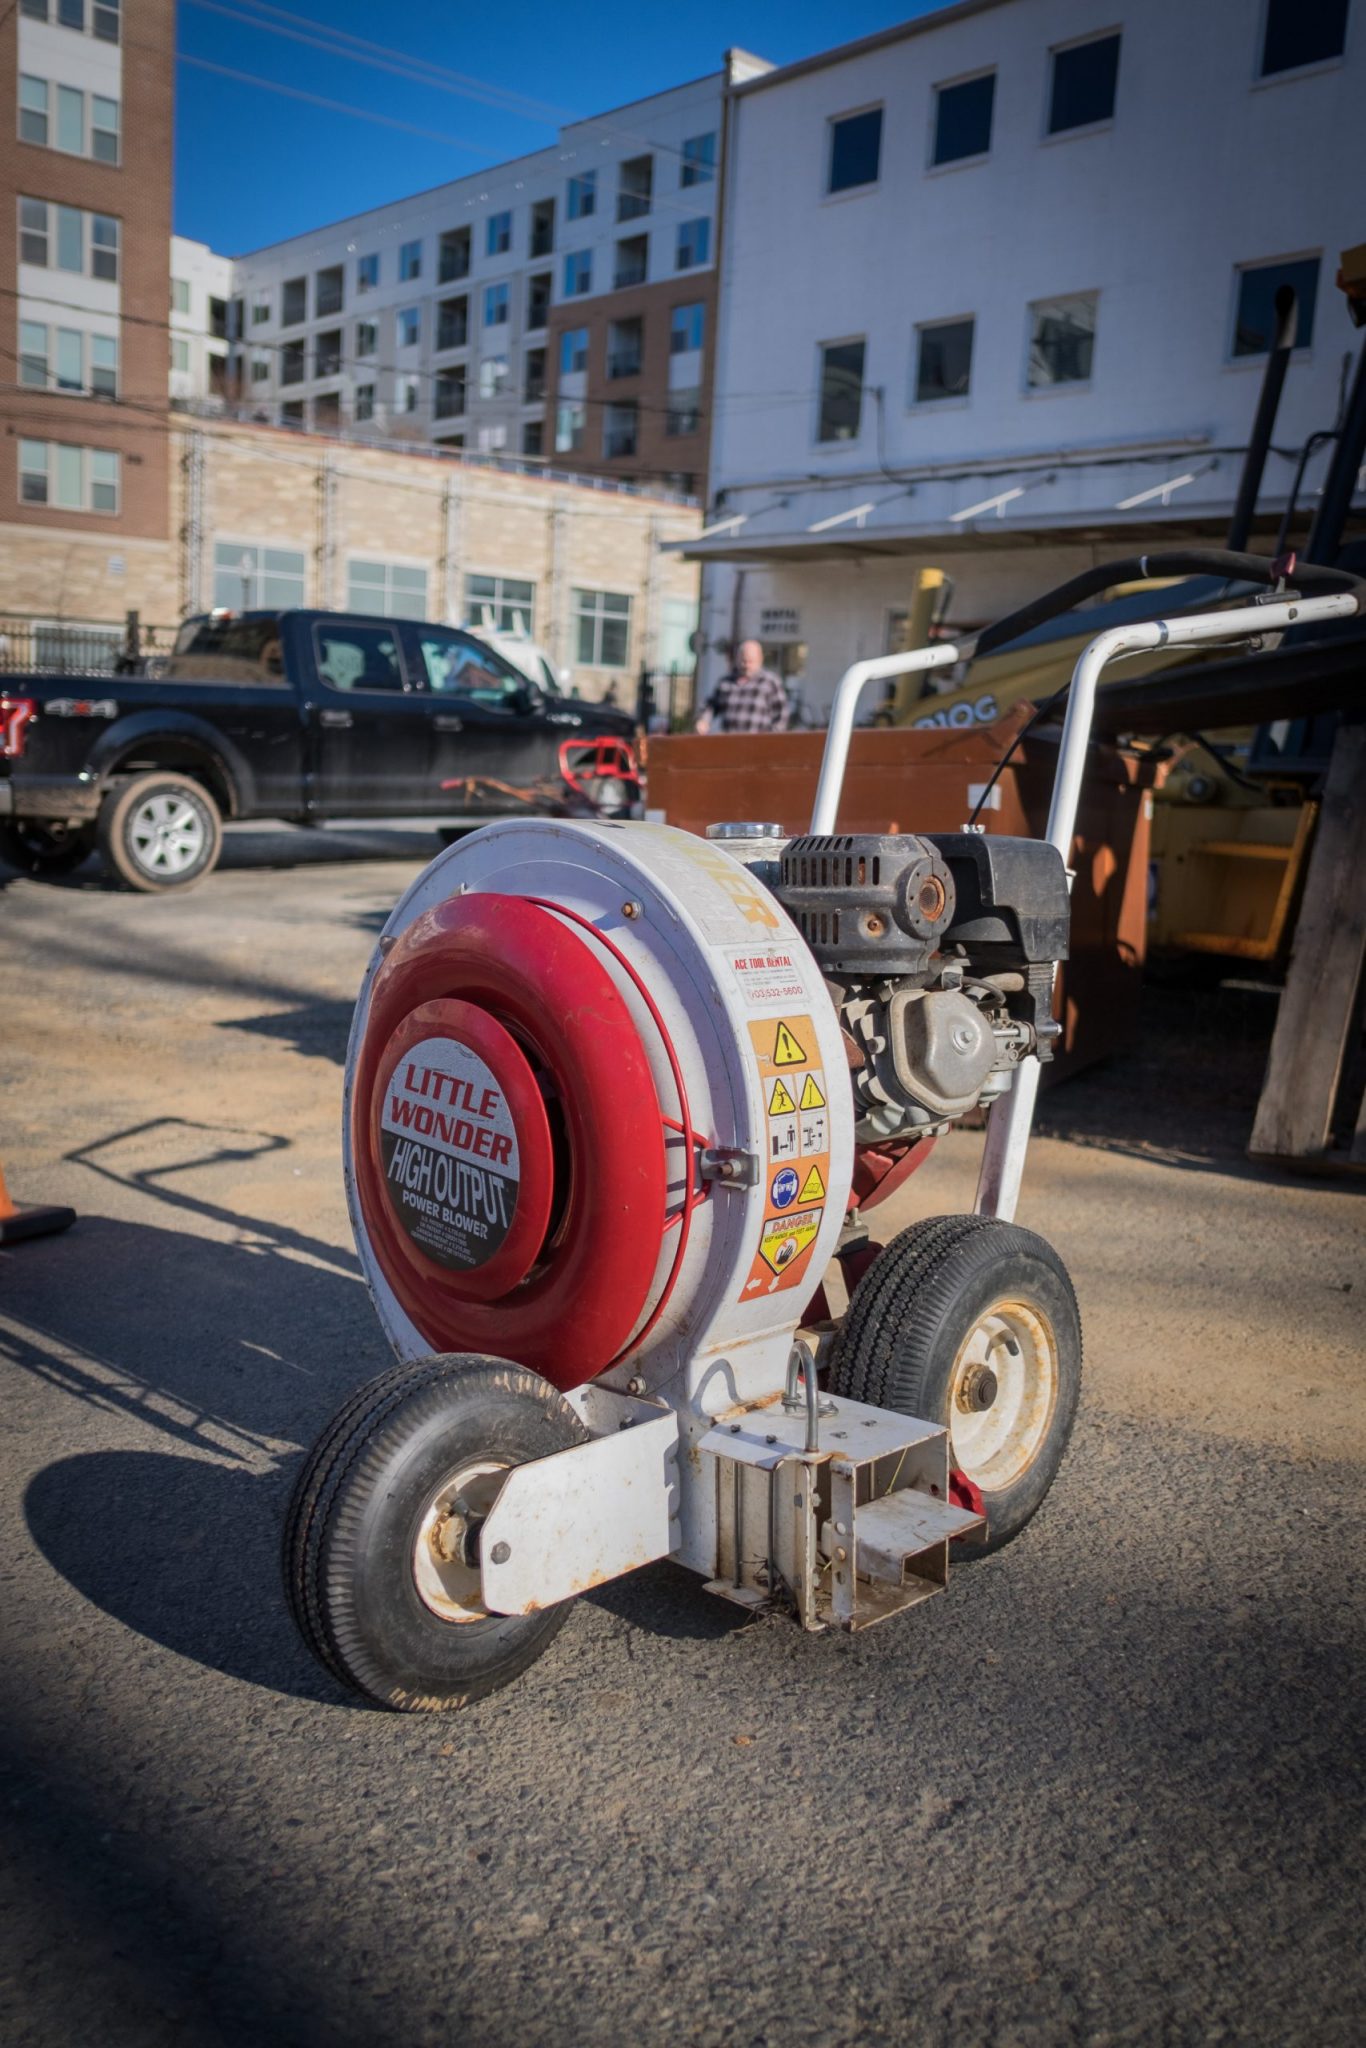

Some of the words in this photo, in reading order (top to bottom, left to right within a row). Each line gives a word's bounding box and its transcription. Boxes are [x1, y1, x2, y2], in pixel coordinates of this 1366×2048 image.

[734, 959, 748, 970] ACE
[749, 957, 766, 969] TOOL
[767, 956, 792, 968] RENTAL
[404, 1063, 500, 1120] LITTLE
[391, 1095, 513, 1166] WONDER
[387, 1138, 434, 1196] HIGH
[434, 1154, 508, 1228] OUTPUT
[402, 1190, 440, 1219] POWER
[442, 1206, 488, 1240] BLOWER
[773, 1213, 813, 1232] DANGER
